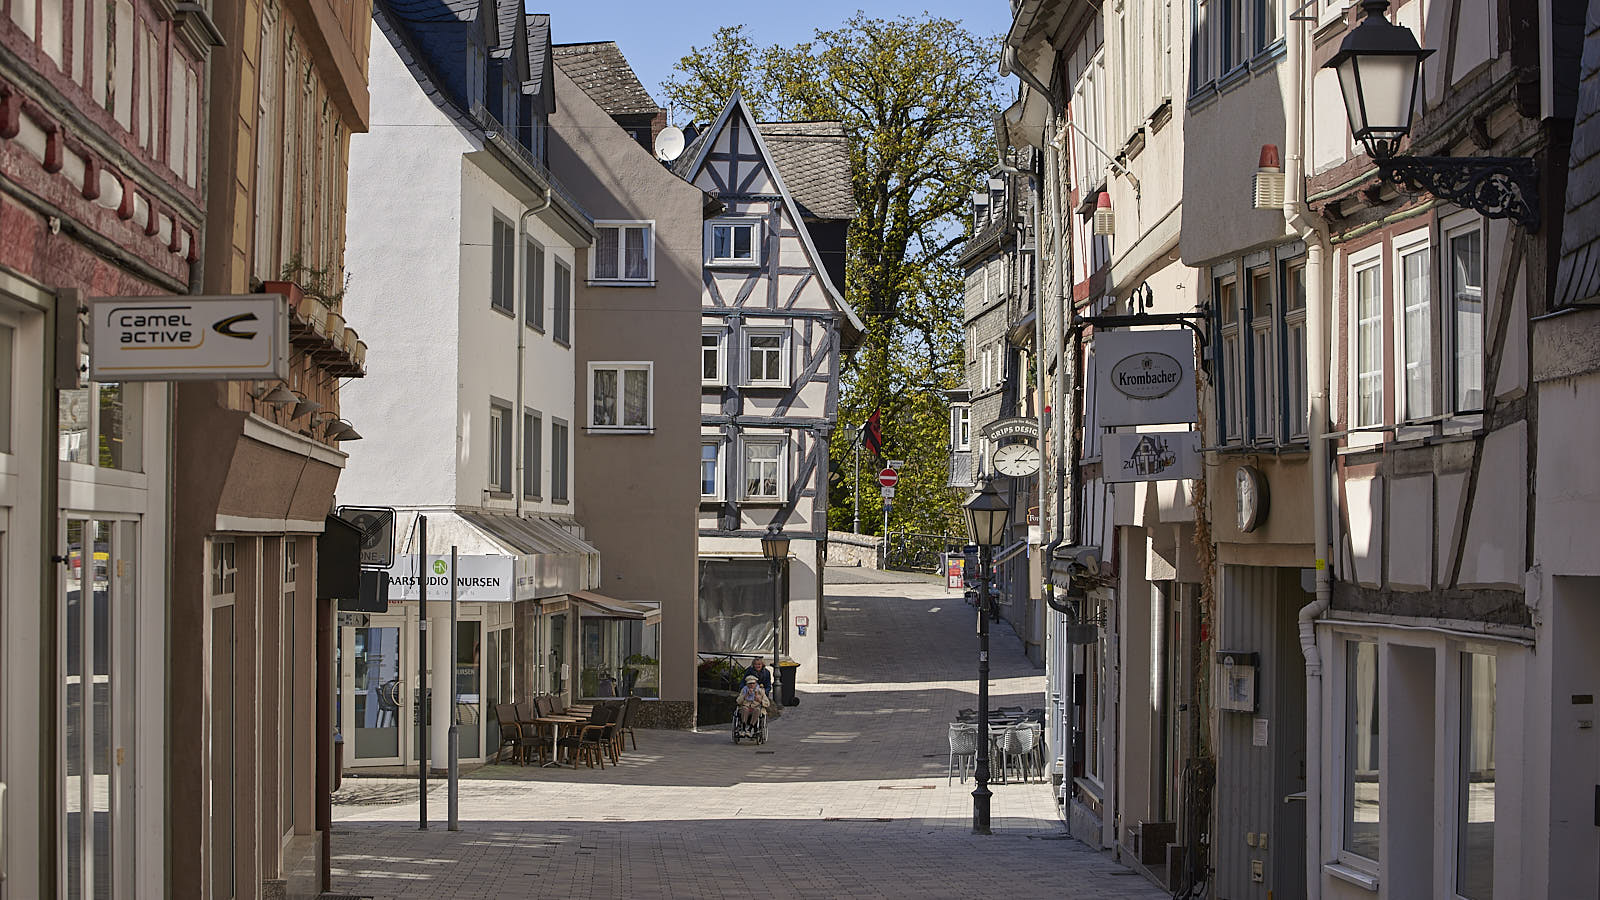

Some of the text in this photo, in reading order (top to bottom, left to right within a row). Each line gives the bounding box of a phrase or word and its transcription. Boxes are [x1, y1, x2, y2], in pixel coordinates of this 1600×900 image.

[1119, 369, 1177, 386] Krombacher
[990, 426, 1014, 439] GRIPS
[1014, 425, 1039, 437] DESIG
[457, 577, 500, 587] NURSEN
